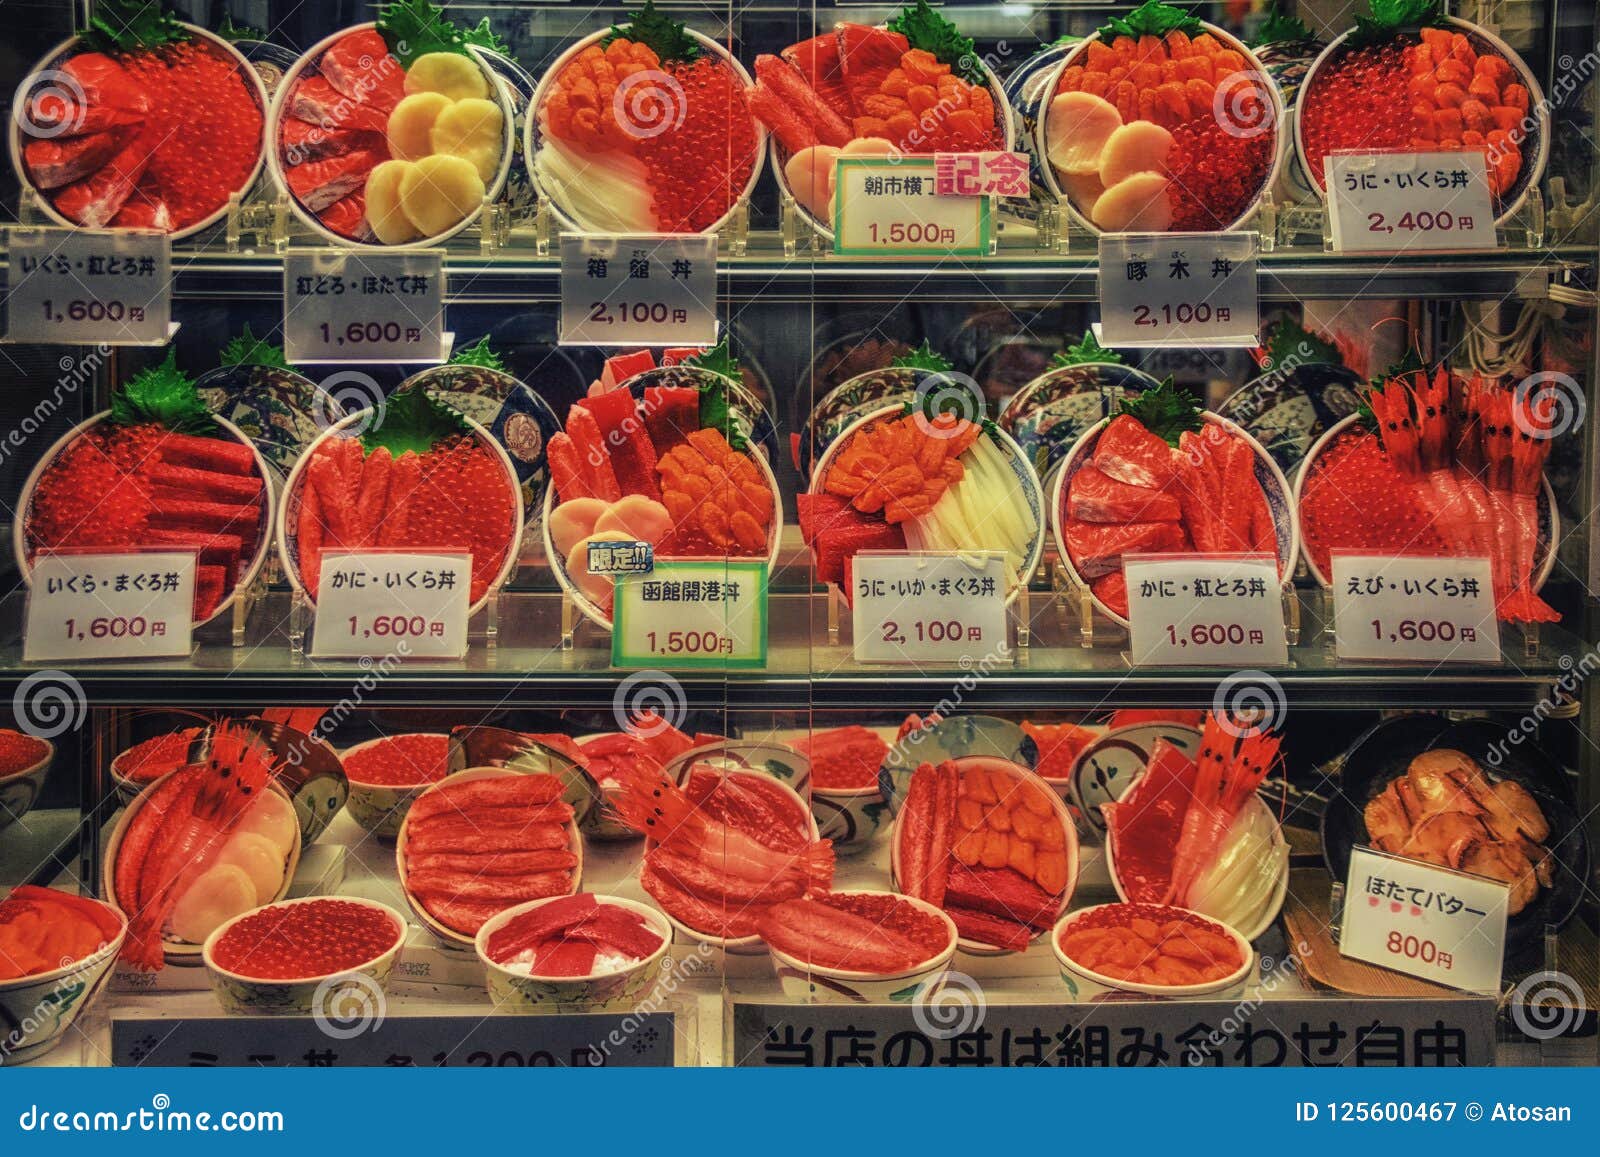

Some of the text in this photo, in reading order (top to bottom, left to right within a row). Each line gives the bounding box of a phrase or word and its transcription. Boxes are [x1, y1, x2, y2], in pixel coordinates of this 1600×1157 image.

[935, 153, 1028, 195] 記念
[1344, 170, 1469, 191] うに・いくら丼
[869, 223, 955, 244] 1,500円
[1367, 211, 1474, 234] 2,400円
[21, 254, 156, 276] いくら・紅とろ丼
[296, 275, 428, 295] 紅とろ・ほたて丼
[43, 300, 145, 322] 1,600円
[590, 302, 687, 324] 2,100円
[1133, 302, 1230, 327] 2,100円
[320, 321, 421, 346] 1,600円
[48, 572, 180, 594] いくら・まぐろ丼
[332, 570, 456, 590] かに・いくら丼
[859, 577, 996, 597] うに・いか・まぐろ丼
[1141, 578, 1266, 598] かに・紅とろ丼
[1347, 576, 1480, 598] えび・いくら丼
[642, 581, 740, 602] 函館開港丼
[65, 616, 166, 641] 1,600円
[348, 615, 444, 639] 1,600円
[882, 620, 982, 644] 2,100円
[1166, 624, 1264, 648] 1,600円
[1371, 620, 1476, 642] 1,600円
[647, 631, 733, 655] 1,500円
[1366, 875, 1487, 917] ほたてバター
[1386, 930, 1453, 970] 800円
[764, 1019, 1468, 1067] 当店の丼は組み合わせ自由
